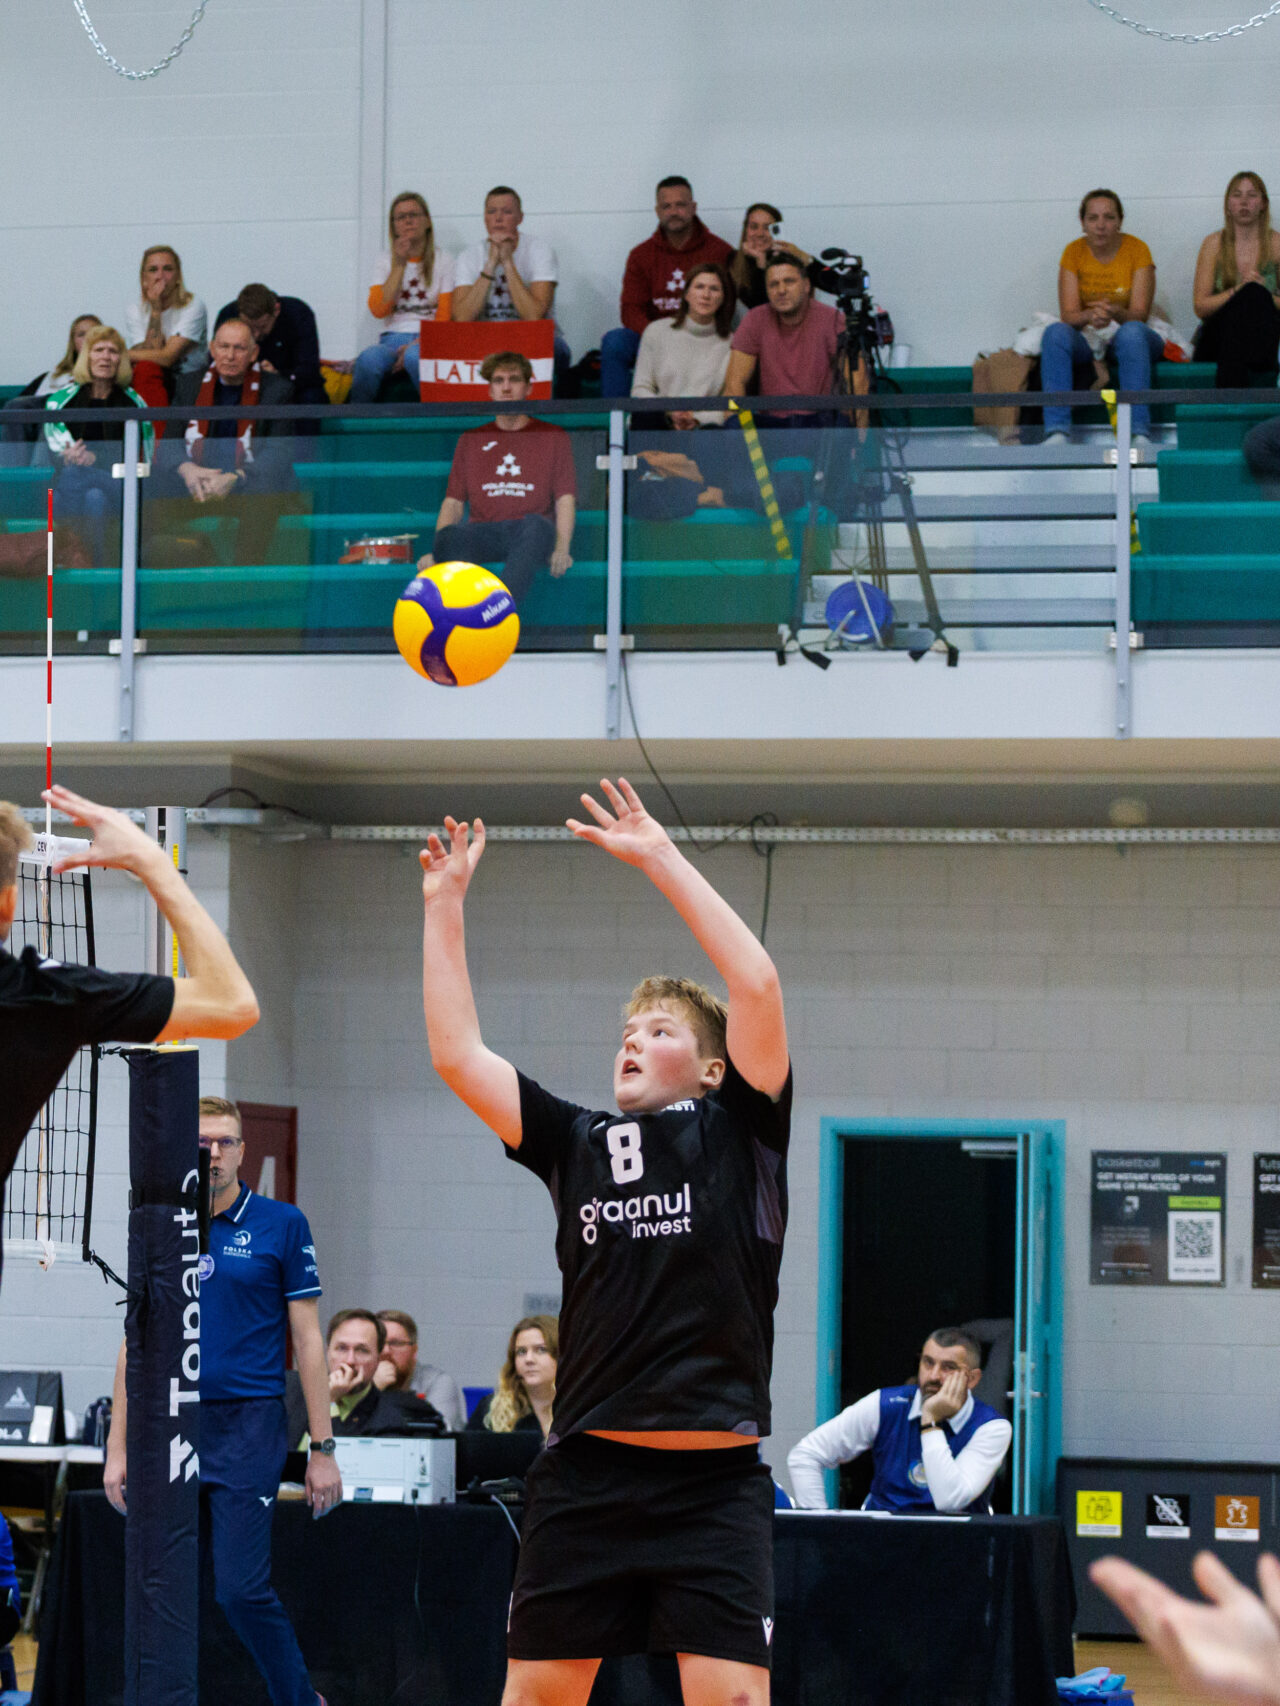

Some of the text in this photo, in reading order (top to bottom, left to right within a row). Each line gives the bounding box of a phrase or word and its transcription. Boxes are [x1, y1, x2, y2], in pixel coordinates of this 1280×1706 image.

[37, 841, 48, 853] CEV
[607, 1122, 644, 1184] 8
[1097, 1157, 1160, 1169] basketball
[580, 1183, 691, 1245] graanul
[632, 1216, 692, 1238] invest
[223, 1245, 252, 1255] POLSKA
